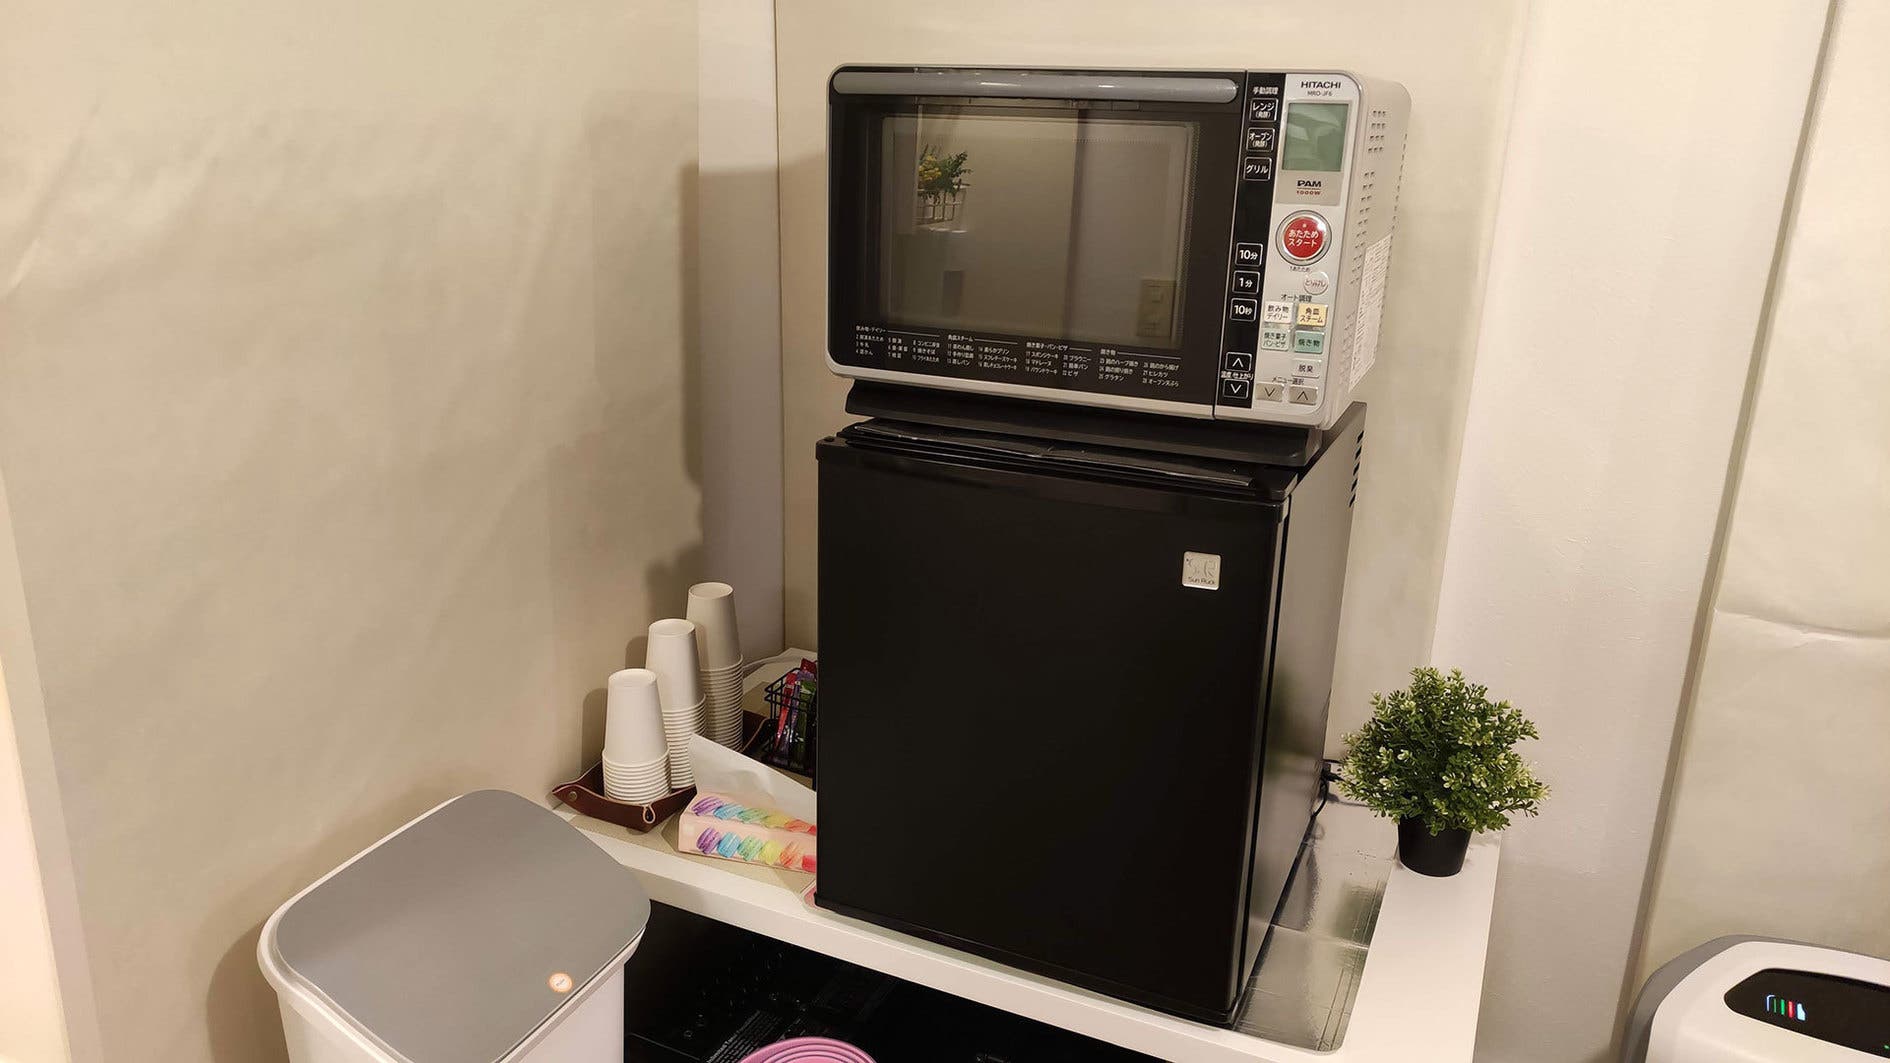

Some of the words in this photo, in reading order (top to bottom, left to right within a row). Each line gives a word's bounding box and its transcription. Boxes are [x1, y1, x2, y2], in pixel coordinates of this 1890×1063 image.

[1300, 81, 1342, 89] HITACHI
[1252, 86, 1279, 95] 手動調理
[1252, 102, 1275, 111] レンジ
[1249, 132, 1272, 141] オーブン
[1246, 164, 1269, 174] グリル
[1288, 230, 1319, 239] あたため
[1288, 238, 1318, 247] スタート
[1239, 250, 1258, 260] 10分
[1238, 278, 1253, 288] 1分
[1280, 294, 1313, 302] オート調理
[1234, 305, 1252, 315] 10秒
[1267, 304, 1290, 314] 飲み物
[1305, 307, 1320, 316] 角皿
[1300, 316, 1324, 324] スチーム
[1264, 332, 1287, 341] 焼き菓子
[1298, 338, 1321, 348] 焼き物
[1298, 365, 1314, 374] 脱臭
[1272, 376, 1304, 385] メニュー選択
